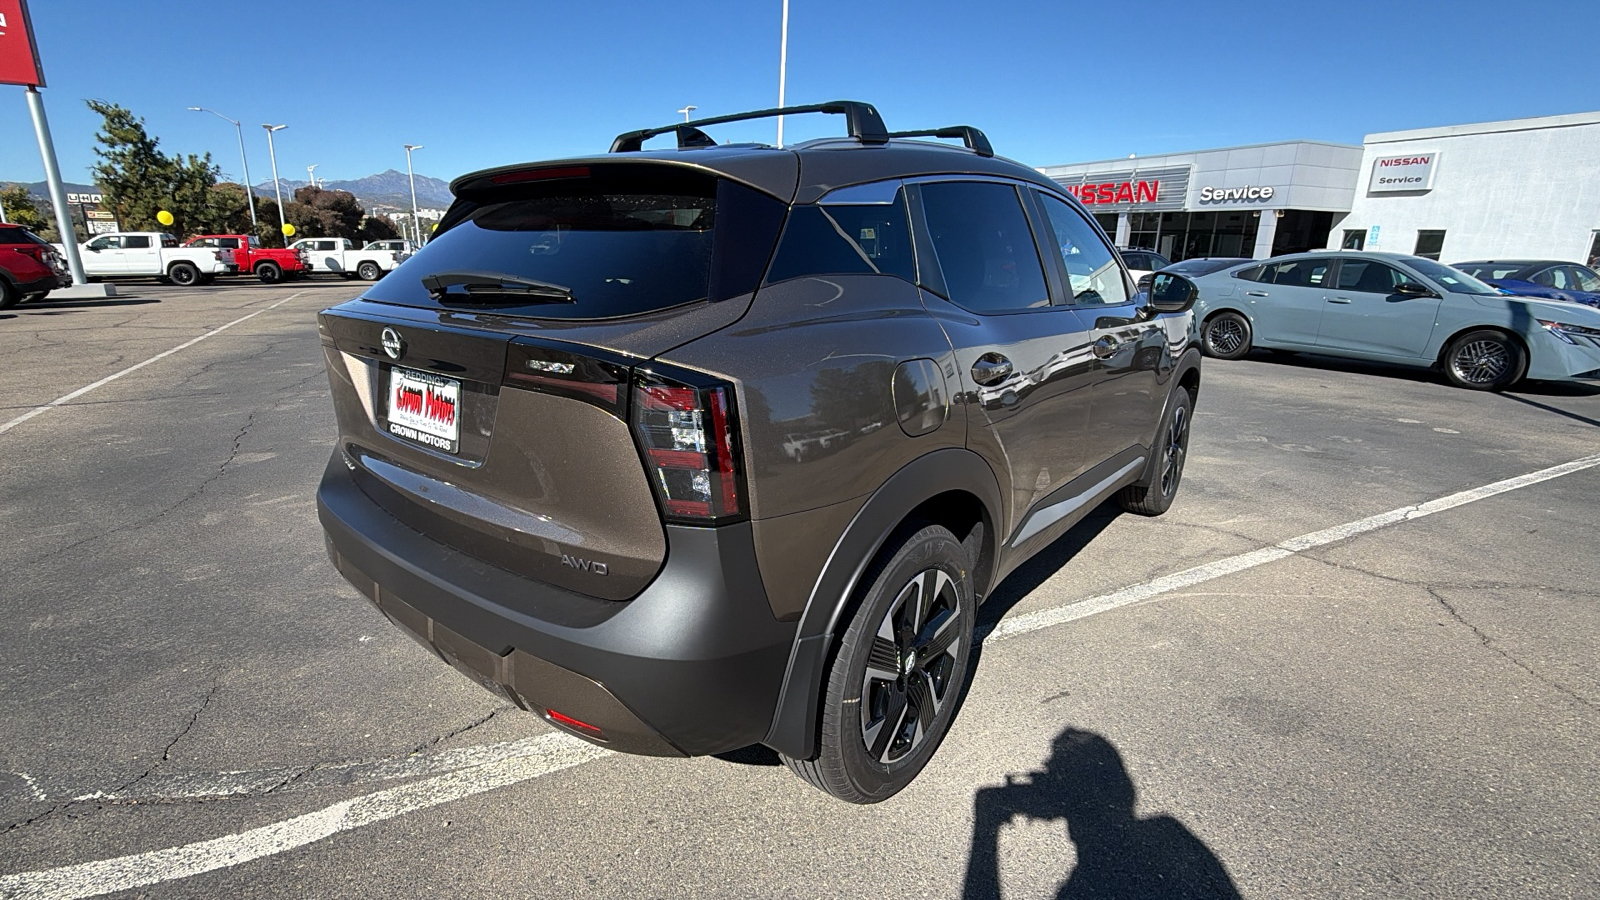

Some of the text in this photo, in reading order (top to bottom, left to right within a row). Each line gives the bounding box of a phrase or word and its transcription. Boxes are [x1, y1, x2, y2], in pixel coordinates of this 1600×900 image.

[1379, 156, 1430, 167] NISSAN
[1378, 176, 1423, 184] Service
[1067, 179, 1160, 205] ISSAN
[1200, 184, 1274, 201] Service
[405, 370, 443, 385] REDDING
[396, 385, 422, 416] Crown
[425, 386, 455, 427] Motors
[390, 423, 418, 440] CROWN
[418, 431, 451, 450] MOTORS
[561, 554, 609, 576] AWD
